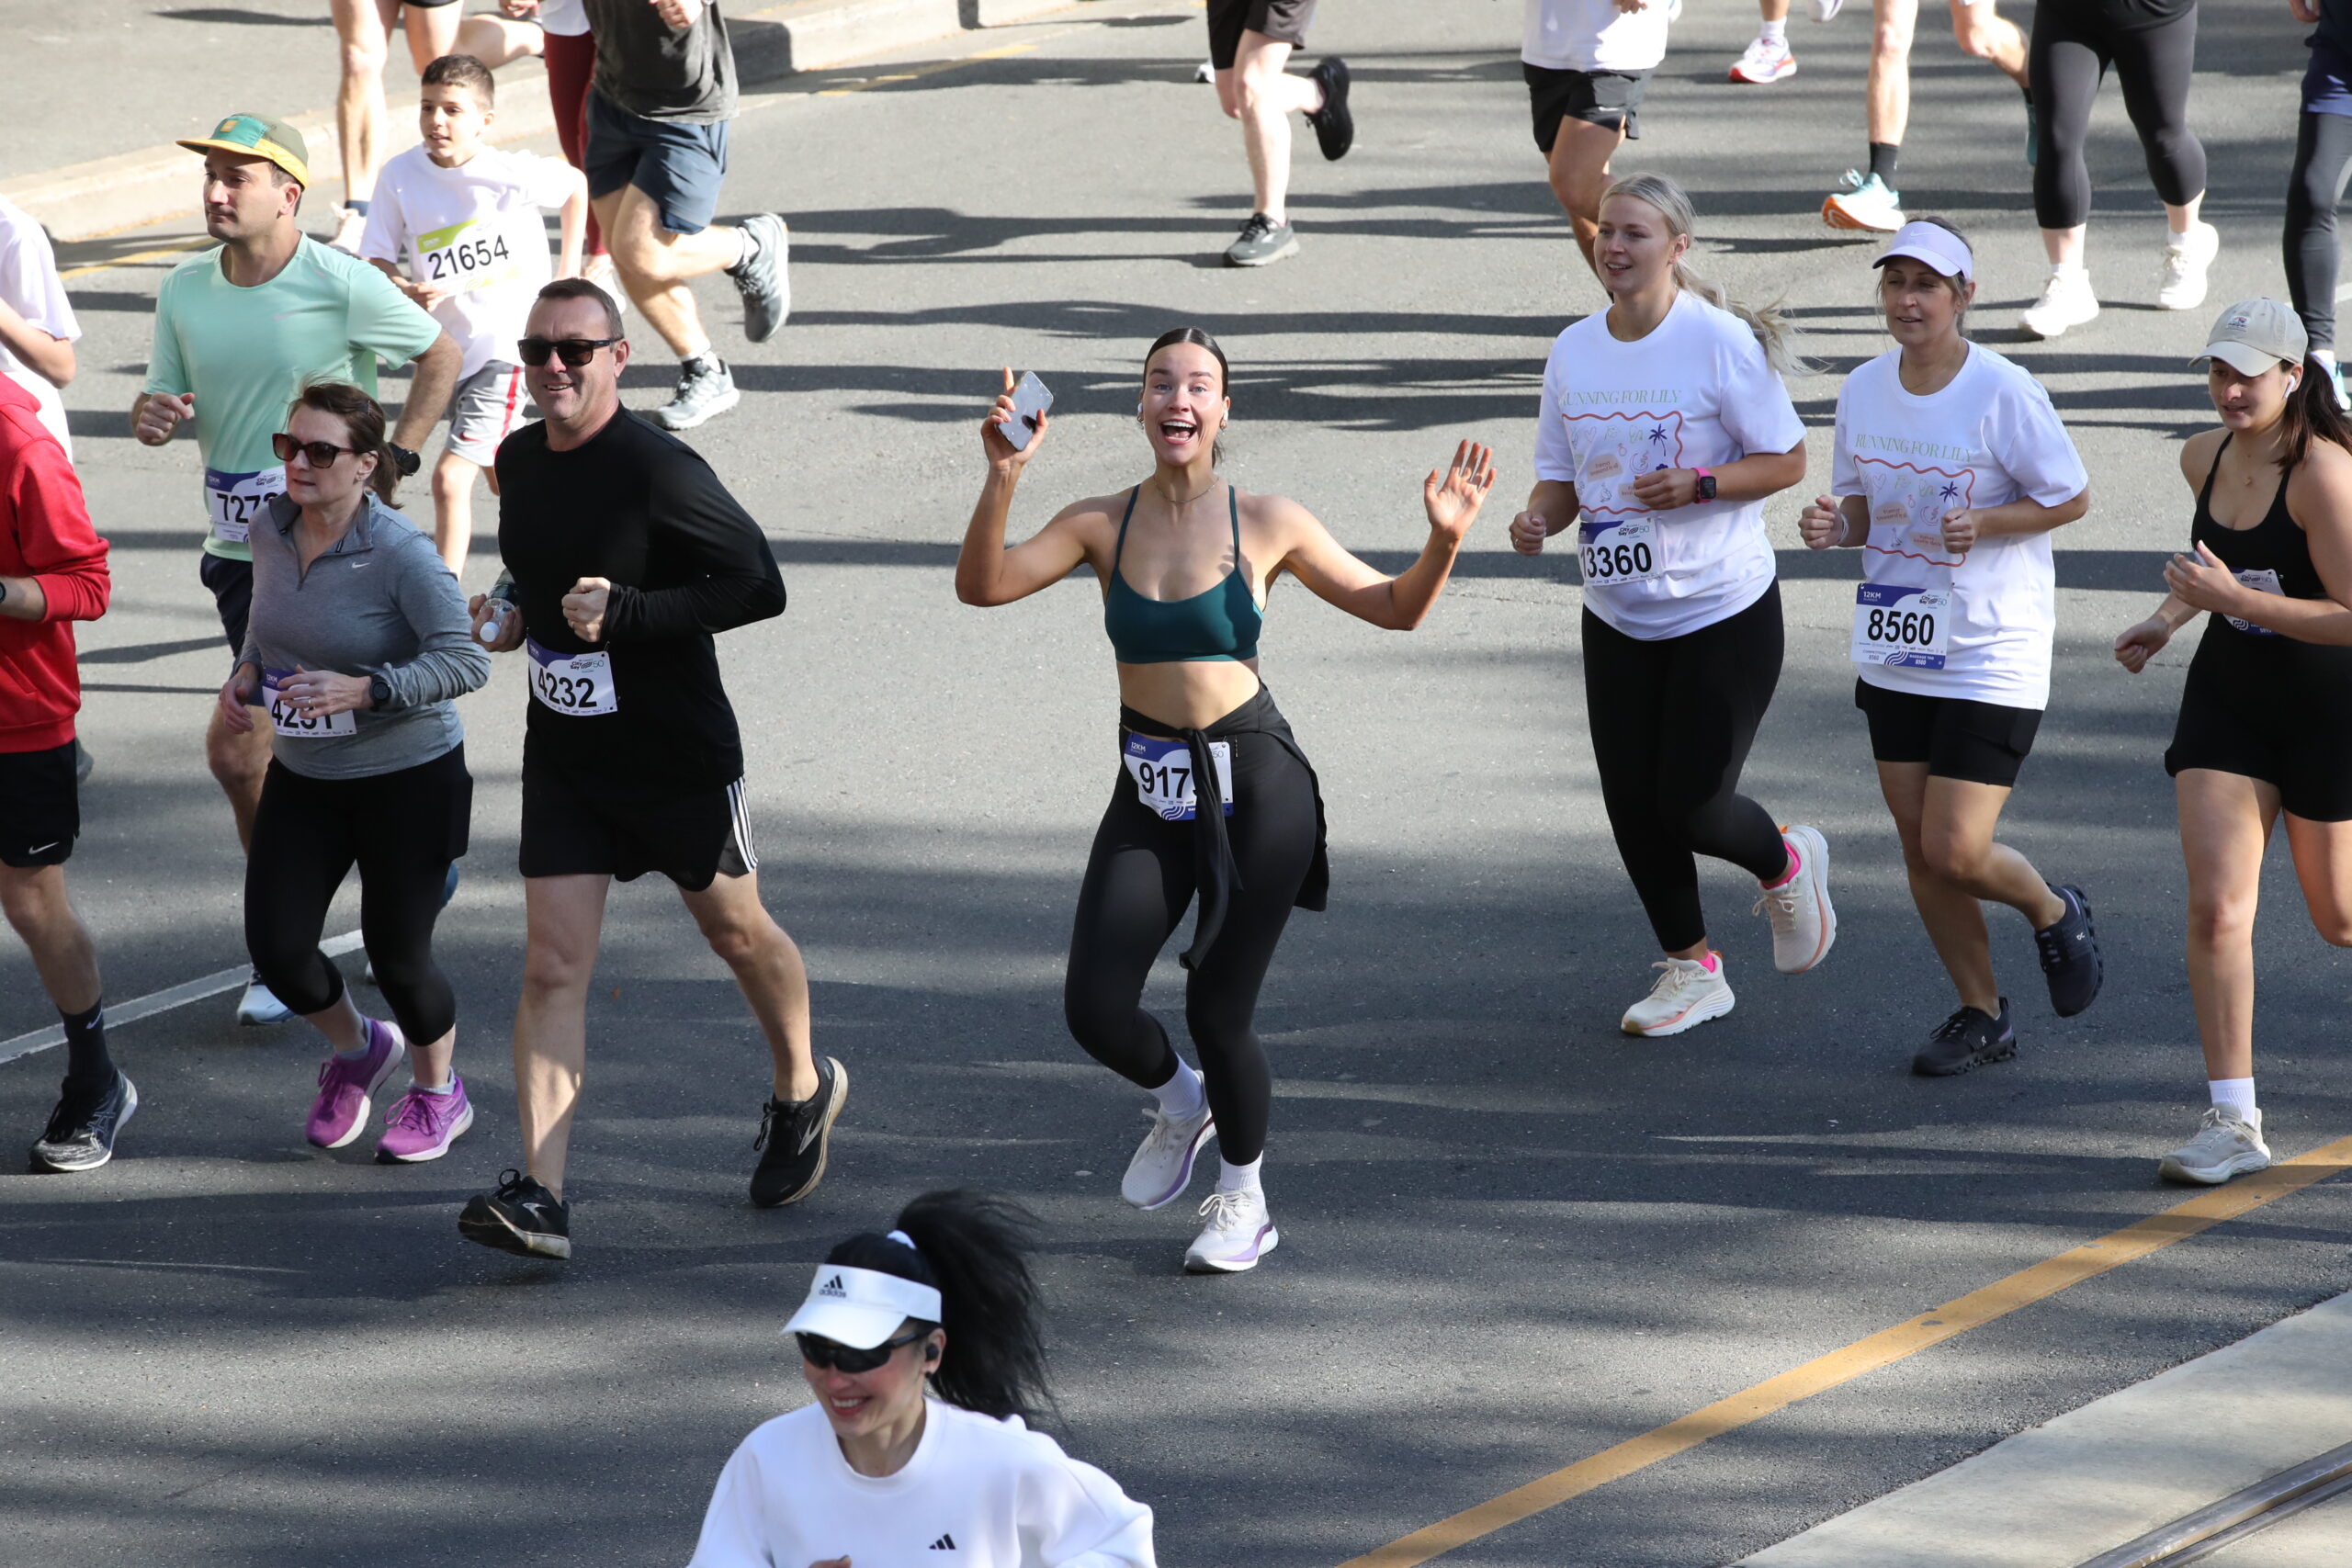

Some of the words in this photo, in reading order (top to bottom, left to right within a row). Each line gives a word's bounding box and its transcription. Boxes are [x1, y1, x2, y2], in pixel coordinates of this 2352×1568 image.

[428, 234, 509, 280] 21654
[1622, 389, 1649, 404] FOR
[1650, 389, 1681, 403] LILY
[1855, 434, 1909, 454] RUNNING
[1911, 441, 1939, 458] FOR
[1940, 444, 1971, 462] LILY
[217, 492, 278, 524] 727
[1581, 542, 1652, 579] 13360
[1868, 609, 1934, 646] 8560
[538, 668, 597, 708] 4232
[1131, 742, 1146, 752] 12KM
[1139, 762, 1196, 798] 917
